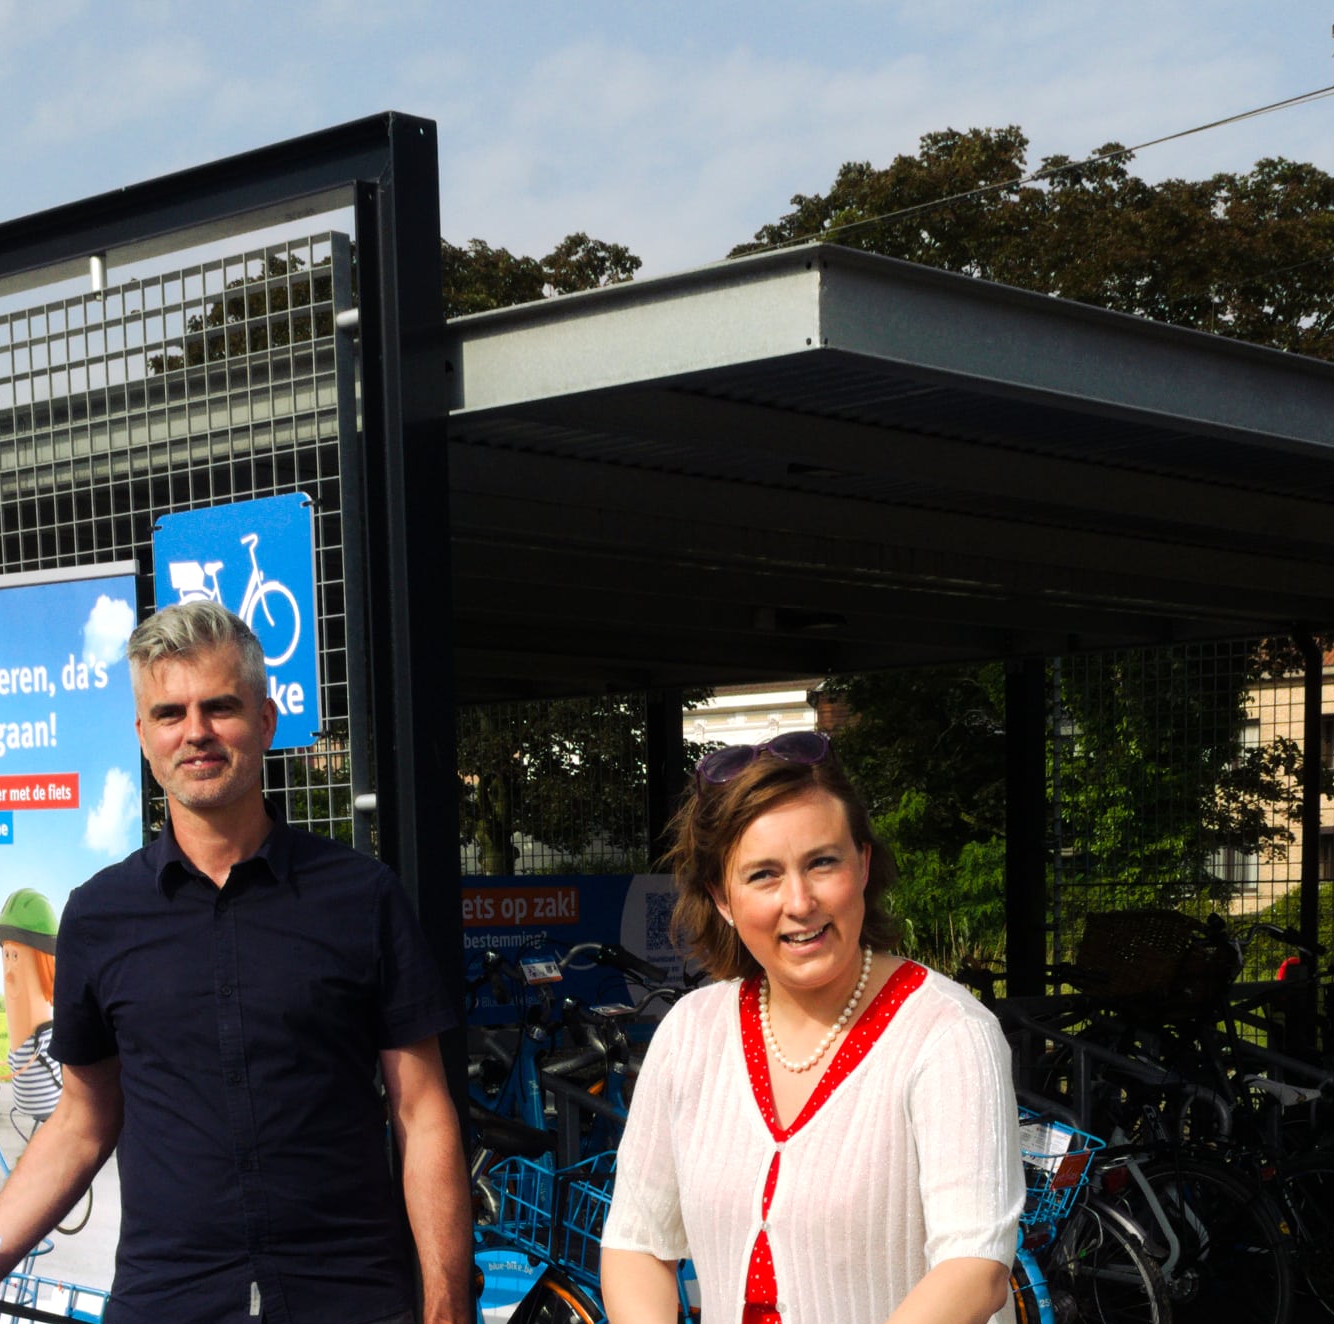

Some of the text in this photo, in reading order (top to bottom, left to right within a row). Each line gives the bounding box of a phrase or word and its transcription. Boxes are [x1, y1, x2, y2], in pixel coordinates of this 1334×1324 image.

[61, 653, 109, 691] da's
[10, 784, 30, 801] met
[33, 784, 46, 801] de
[48, 783, 72, 800] fiets
[462, 890, 576, 925] ets op zak!
[463, 930, 547, 950] bestemming?
